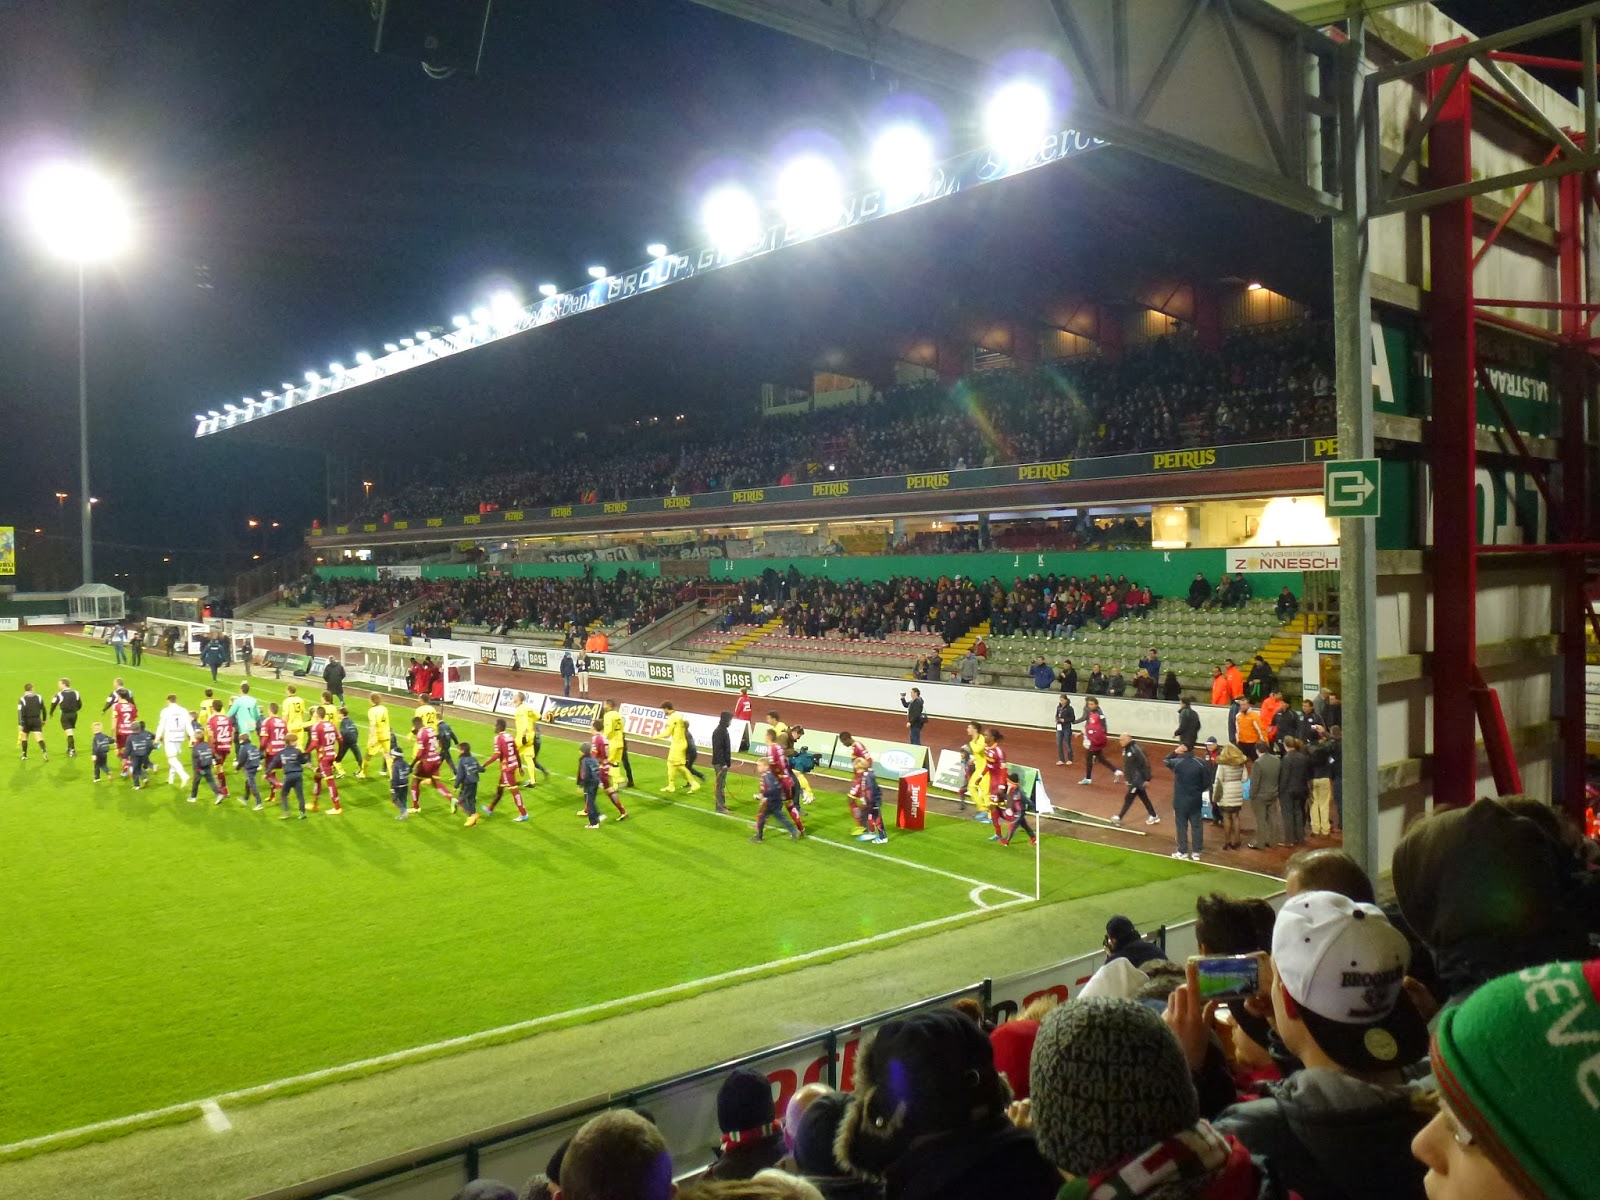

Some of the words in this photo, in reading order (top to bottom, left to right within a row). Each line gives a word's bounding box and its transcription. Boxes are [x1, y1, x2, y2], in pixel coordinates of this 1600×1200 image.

[607, 254, 689, 299] GROUP
[1153, 449, 1216, 470] PETRUS
[1018, 462, 1070, 481] PETRUS
[907, 473, 949, 490] PETRUS
[813, 482, 849, 497] PETRUS
[733, 489, 764, 503] PETRUS
[604, 502, 627, 514] PETRUS
[664, 497, 691, 510] PETRUS
[1163, 552, 1170, 562] K
[529, 653, 547, 665] BASE
[588, 659, 605, 671] ASE
[618, 659, 646, 670] CHALLENGE
[624, 668, 634, 677] YOU
[635, 670, 647, 679] WIN
[650, 665, 673, 679] BASE
[675, 664, 685, 673] WE
[686, 665, 720, 677] CHALLENGE
[695, 677, 707, 686] YOU
[708, 678, 721, 687] WIN
[725, 672, 750, 687] BASE
[123, 712, 131, 723] 2
[217, 726, 230, 738] 24
[325, 732, 336, 744] 19
[508, 742, 514, 754] 5
[911, 784, 920, 818] Jupiler
